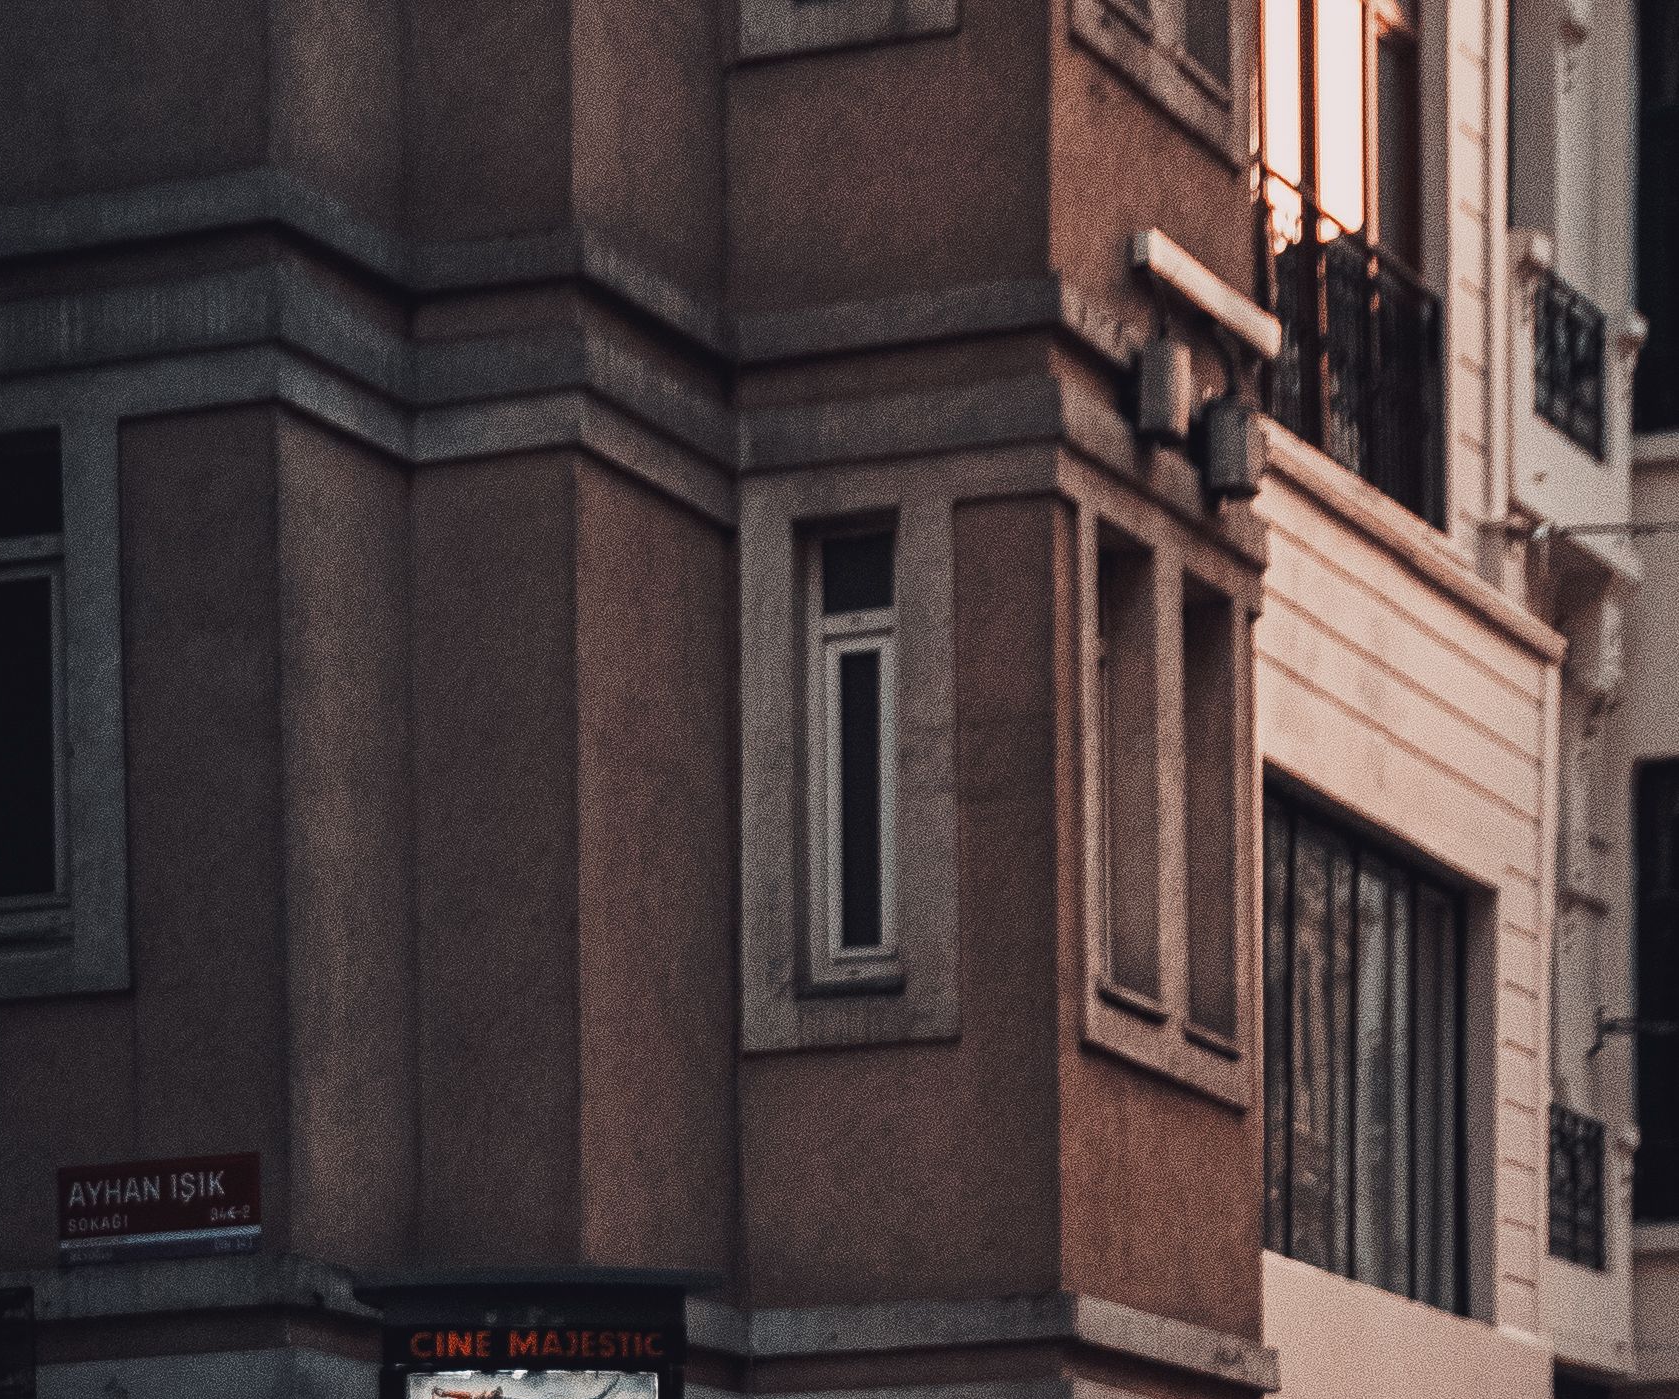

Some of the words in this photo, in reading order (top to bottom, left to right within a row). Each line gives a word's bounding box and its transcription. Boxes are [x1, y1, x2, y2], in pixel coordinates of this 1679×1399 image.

[68, 1175, 161, 1207] AYHAN
[171, 1169, 226, 1204] IŞIK
[67, 1213, 128, 1232] SOKAĞI
[409, 1329, 492, 1359] CINE
[507, 1328, 664, 1359] MAJESTIC
